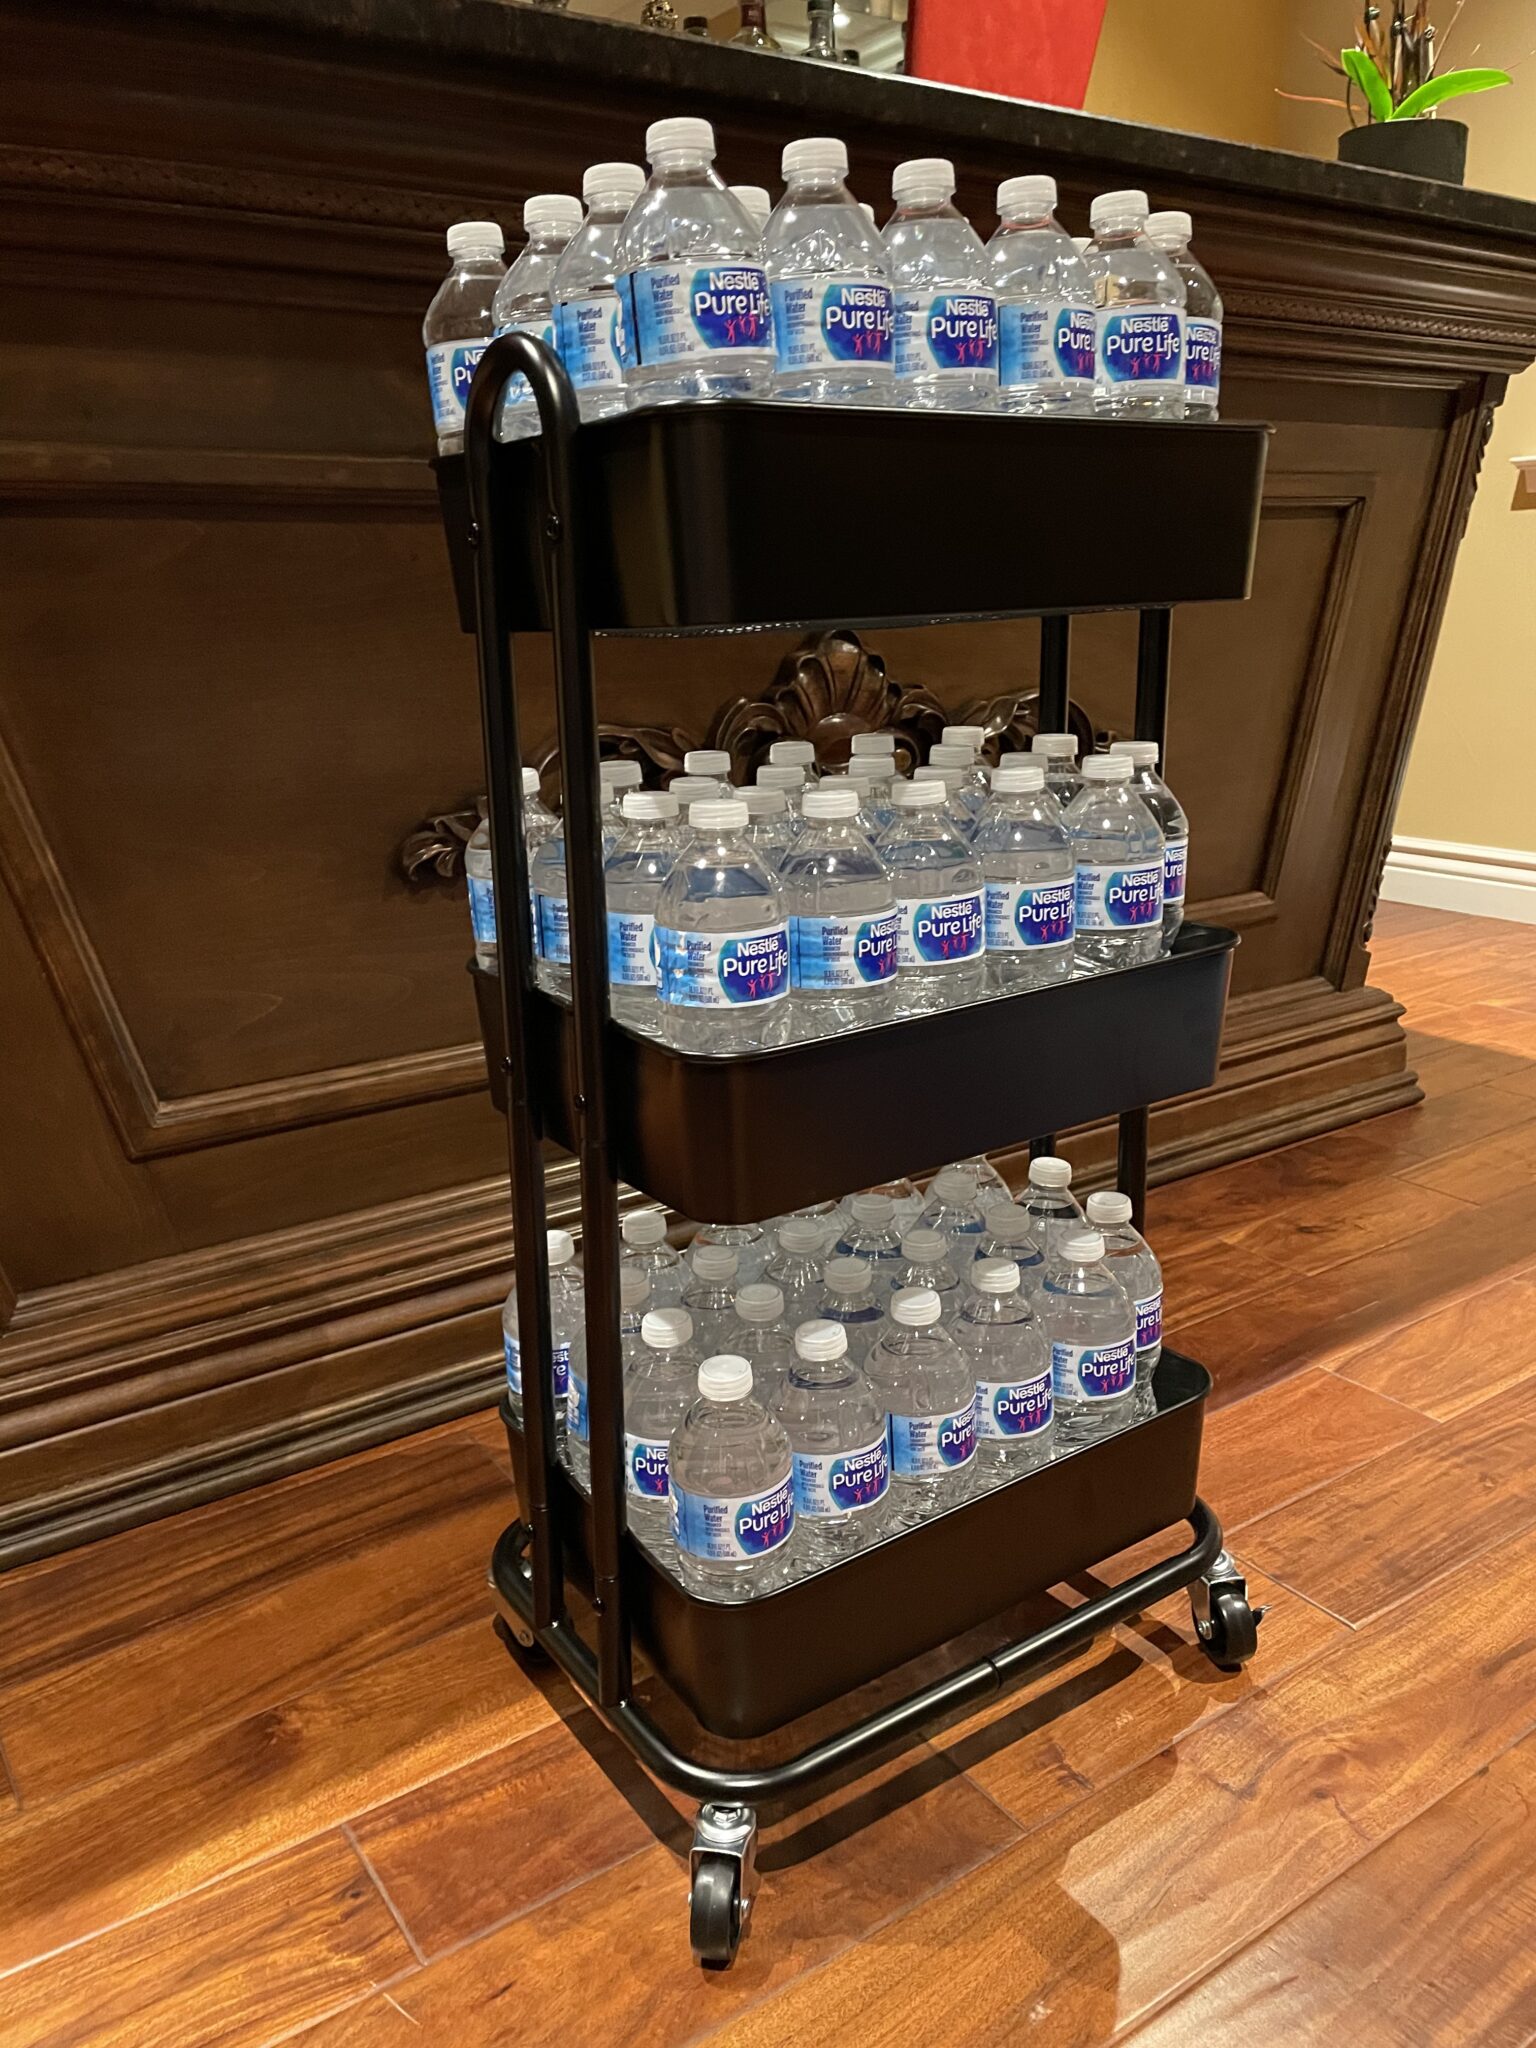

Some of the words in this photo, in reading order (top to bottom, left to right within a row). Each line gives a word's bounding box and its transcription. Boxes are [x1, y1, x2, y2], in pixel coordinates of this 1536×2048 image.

[1107, 335, 1154, 356] Pure
[1156, 333, 1180, 360] Life
[1186, 345, 1209, 360] ure
[918, 921, 960, 938] Pure
[723, 957, 767, 977] Pure
[769, 950, 788, 976] Life
[998, 1399, 1035, 1415] Pure
[833, 1469, 872, 1490] Pure
[739, 1510, 779, 1535] Pure
